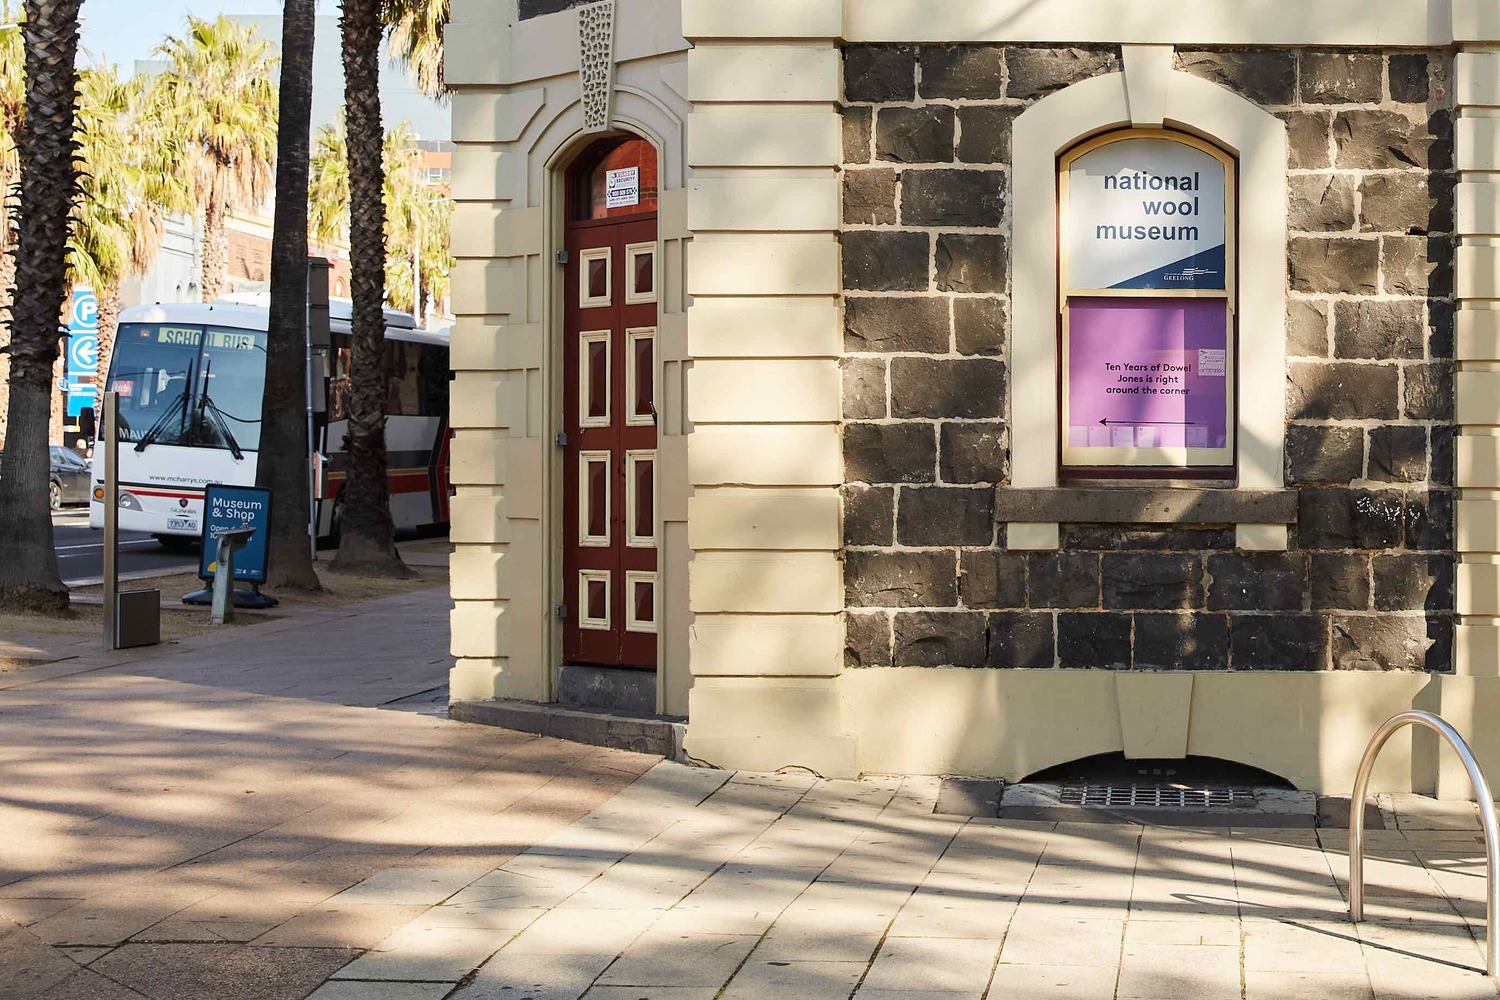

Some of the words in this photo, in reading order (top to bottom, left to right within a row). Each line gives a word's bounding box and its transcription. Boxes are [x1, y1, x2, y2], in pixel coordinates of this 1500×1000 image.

[1103, 171, 1199, 191] national
[1142, 196, 1199, 216] wool
[1096, 225, 1199, 241] museum
[1105, 363, 1121, 371] Ten
[1123, 363, 1148, 371] Years
[1150, 363, 1161, 371] of
[1163, 363, 1191, 372] Dowel
[1117, 375, 1143, 383] Jones
[1146, 375, 1153, 383] is
[1155, 375, 1179, 385] right
[1105, 386, 1140, 395] around
[1142, 386, 1158, 395] the
[1159, 387, 1190, 395] corner
[212, 497, 262, 510] Museum
[212, 508, 223, 518] &
[226, 508, 255, 522] Shop
